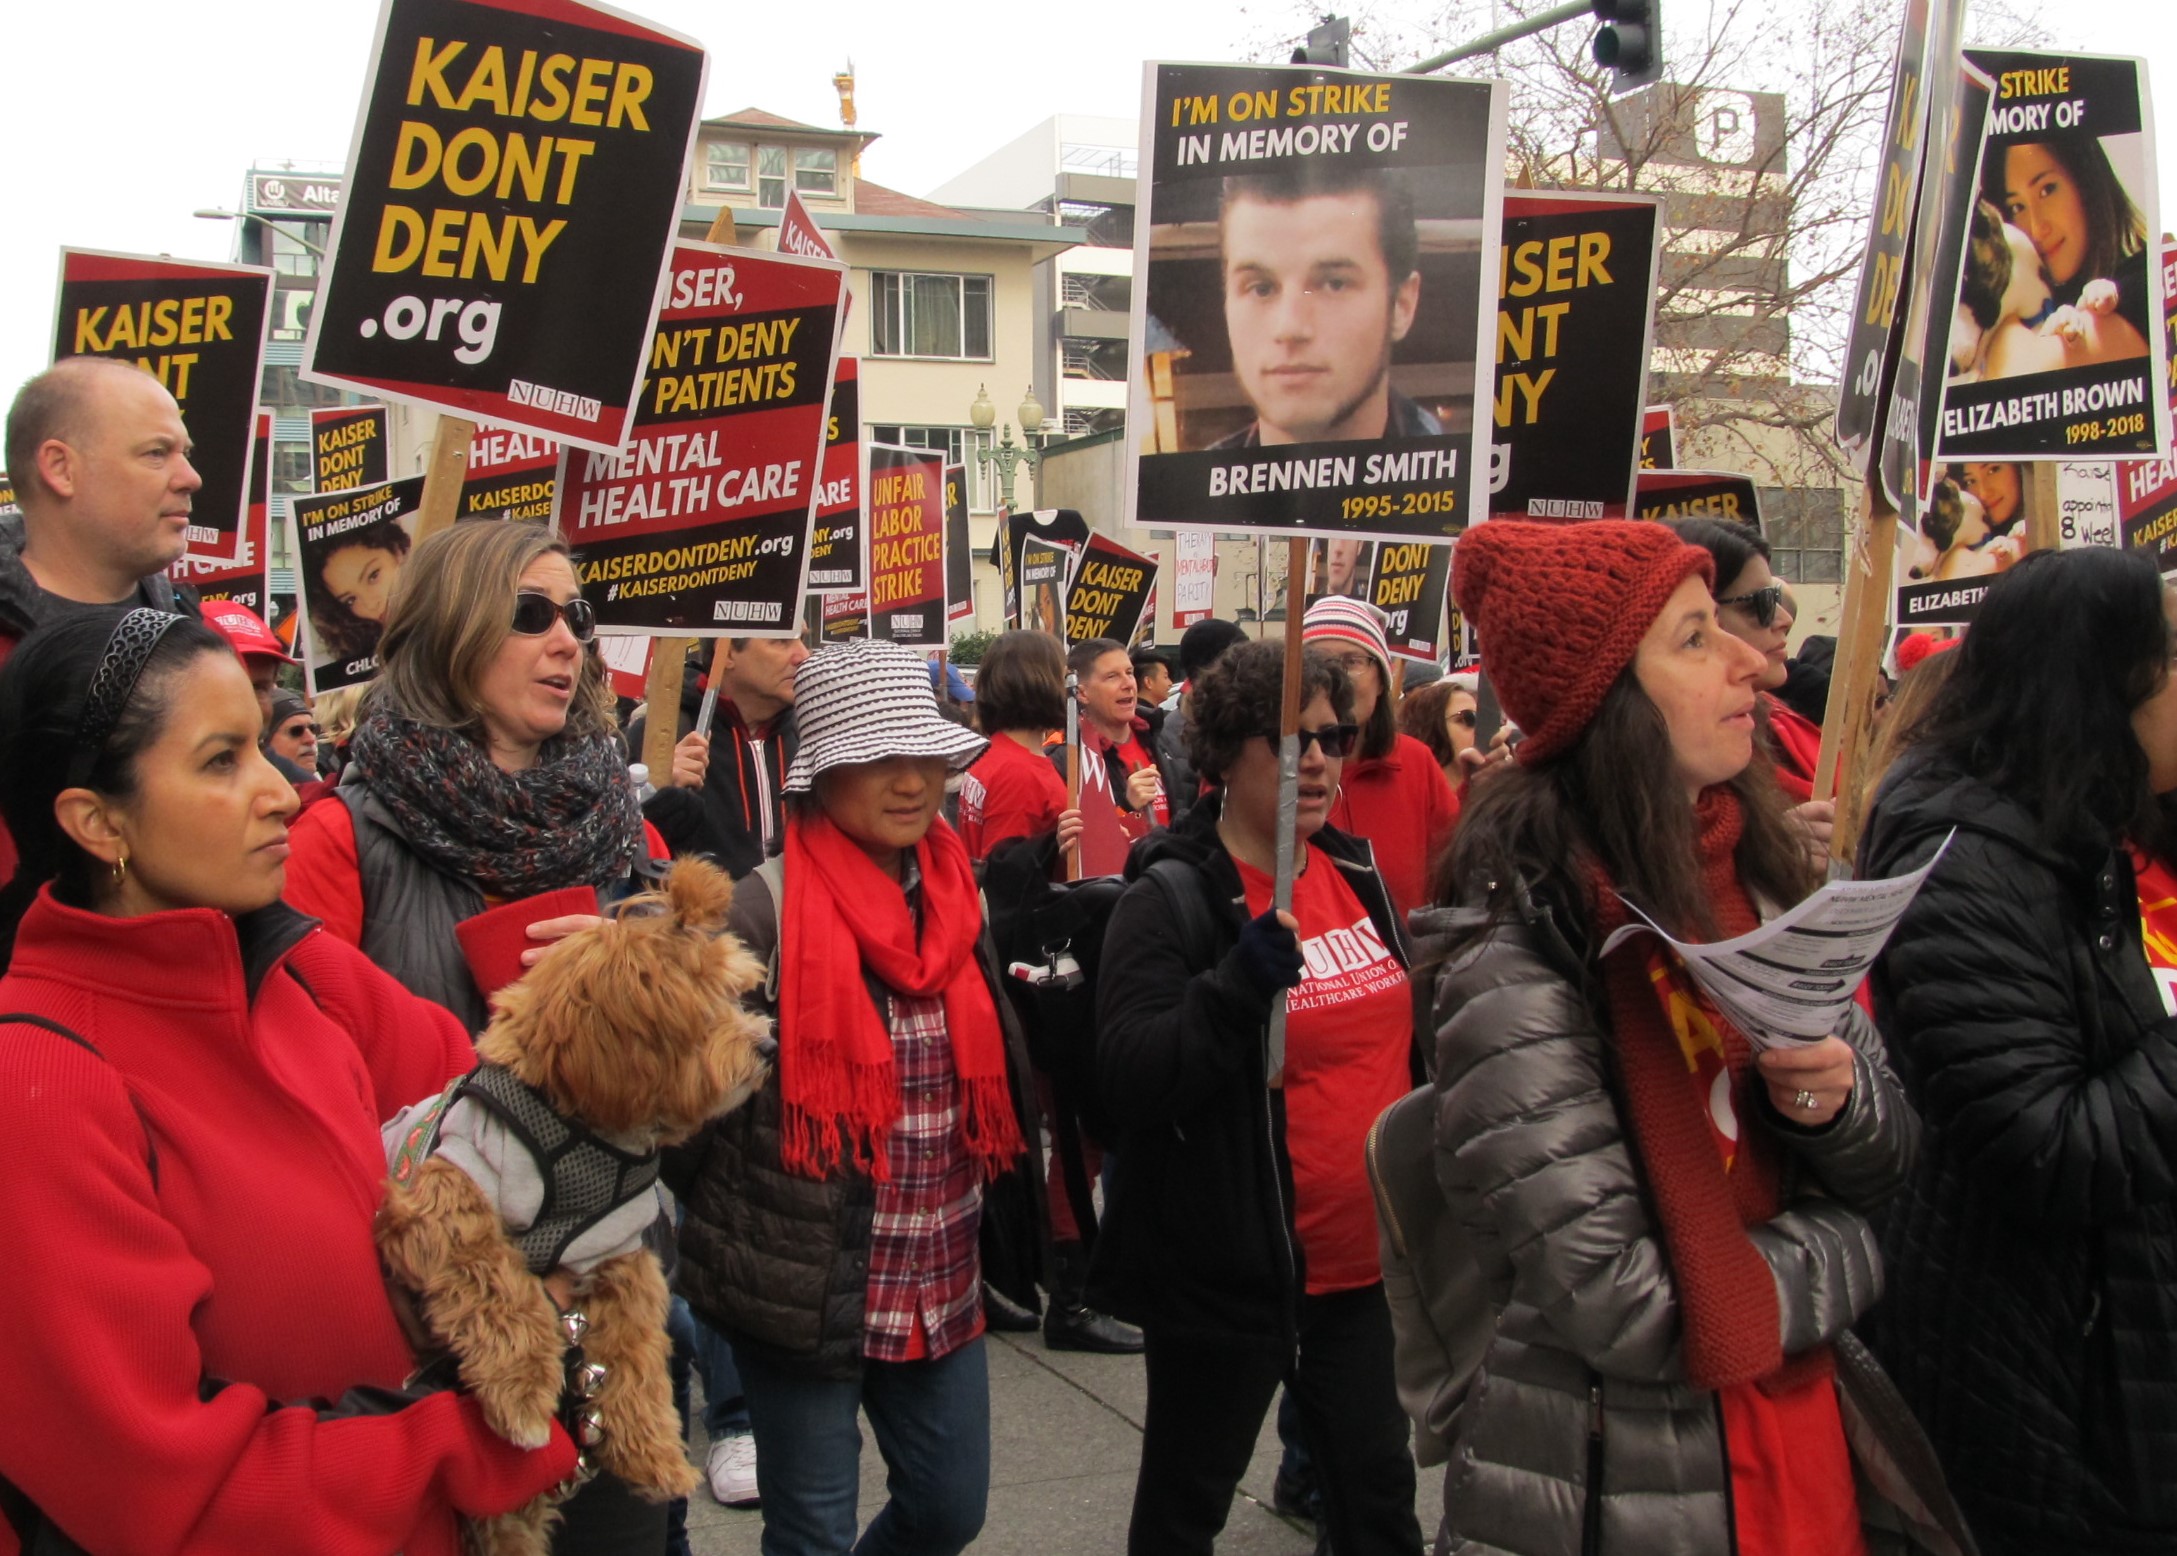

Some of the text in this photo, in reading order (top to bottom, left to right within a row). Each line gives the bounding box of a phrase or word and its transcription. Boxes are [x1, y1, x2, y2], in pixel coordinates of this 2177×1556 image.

[407, 37, 654, 131] KAISER
[2000, 67, 2070, 99] STRIKE
[1172, 83, 1392, 127] I'M ON STRIKE
[1988, 100, 2084, 136] MORY OF
[1177, 122, 1408, 166] IN MEMORY OF
[389, 121, 595, 205] DONT
[372, 205, 567, 283] DENY
[75, 296, 233, 353] KAISER
[360, 296, 501, 364] .org
[716, 318, 800, 363] DENY
[507, 379, 601, 424] NUHW
[654, 362, 797, 414] PATIENTS
[1944, 391, 2058, 436] ELIZABETH
[2062, 377, 2143, 416] BROWN
[319, 419, 376, 454] KAISER
[2065, 414, 2145, 444] 1998-2018
[320, 445, 365, 477] DONT
[583, 431, 722, 483] MENTAL
[1209, 456, 1356, 497] BRENNEN
[1363, 449, 1457, 484] SMITH
[303, 484, 393, 527] I'M ON STRIKE
[578, 460, 802, 529] HEALTH CARE
[817, 479, 850, 507] ARE
[874, 473, 926, 507] UNFAIR
[1342, 491, 1454, 519] 1995-2015
[1642, 493, 1743, 522] KAISER
[308, 497, 401, 541] IN MEMORY OF
[873, 505, 923, 540] LABOR
[1528, 499, 1603, 519] NUHW
[873, 533, 940, 573] PRACTICE
[1381, 543, 1432, 574] DONT
[607, 560, 758, 602] #KAISERDONTDENY
[808, 570, 852, 583] NUHW
[874, 568, 922, 605] STRIKE
[1080, 561, 1143, 593] KAISER
[1376, 574, 1426, 606] DENY
[713, 600, 782, 622] NUHW
[1070, 588, 1123, 616] DONT
[1066, 614, 1111, 639] DENY
[1287, 977, 1350, 999] NATIONAL
[1351, 964, 1386, 985] UNION
